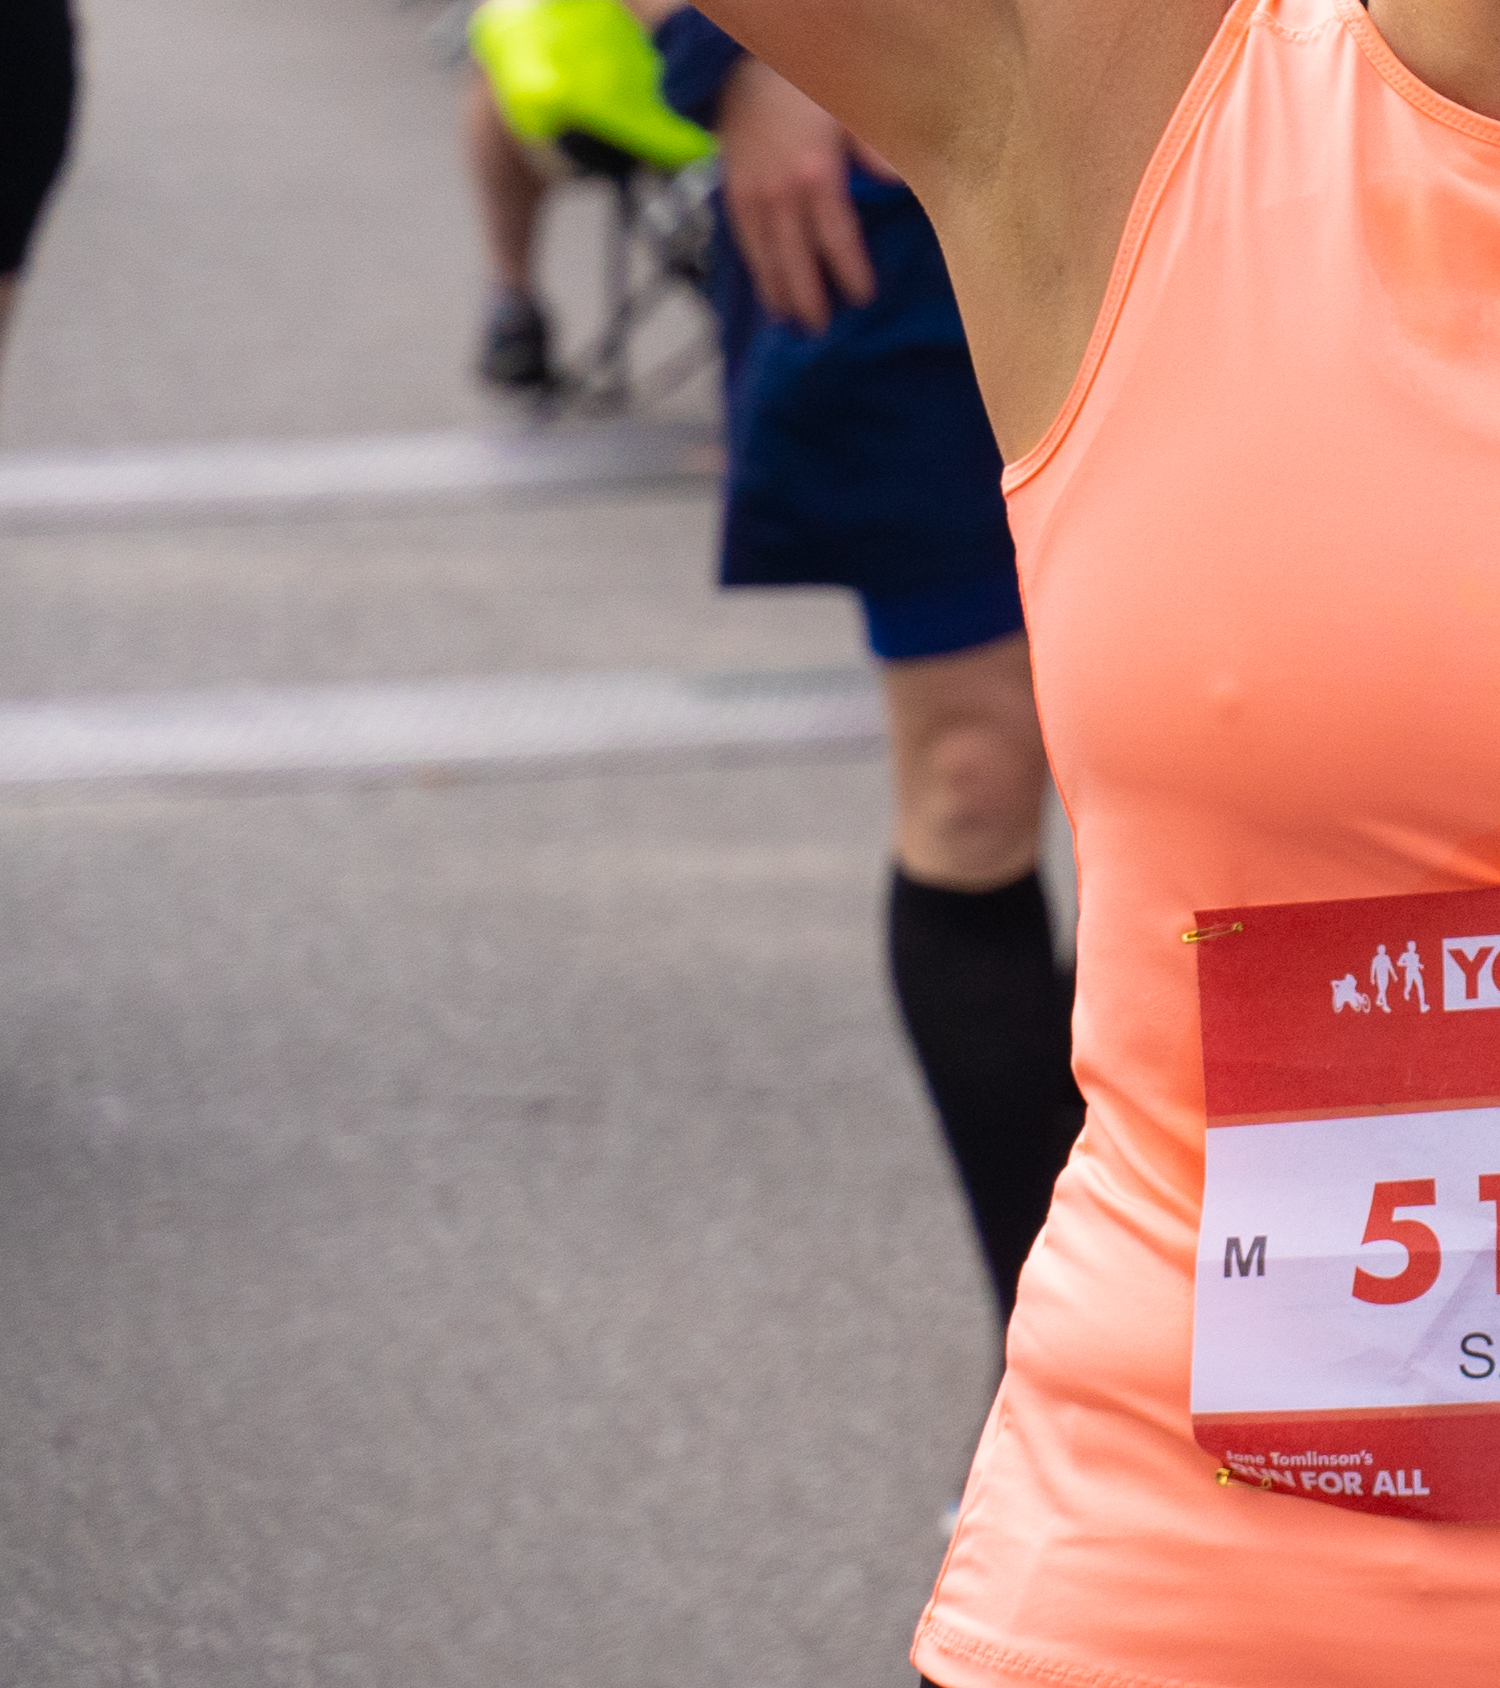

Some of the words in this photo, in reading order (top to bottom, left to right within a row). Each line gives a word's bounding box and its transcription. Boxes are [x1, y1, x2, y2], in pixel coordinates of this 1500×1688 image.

[1223, 1234, 1268, 1278] M
[1270, 1449, 1374, 1467] Tomlinson's
[1301, 1470, 1364, 1496] FOR
[1372, 1468, 1430, 1497] ALL
